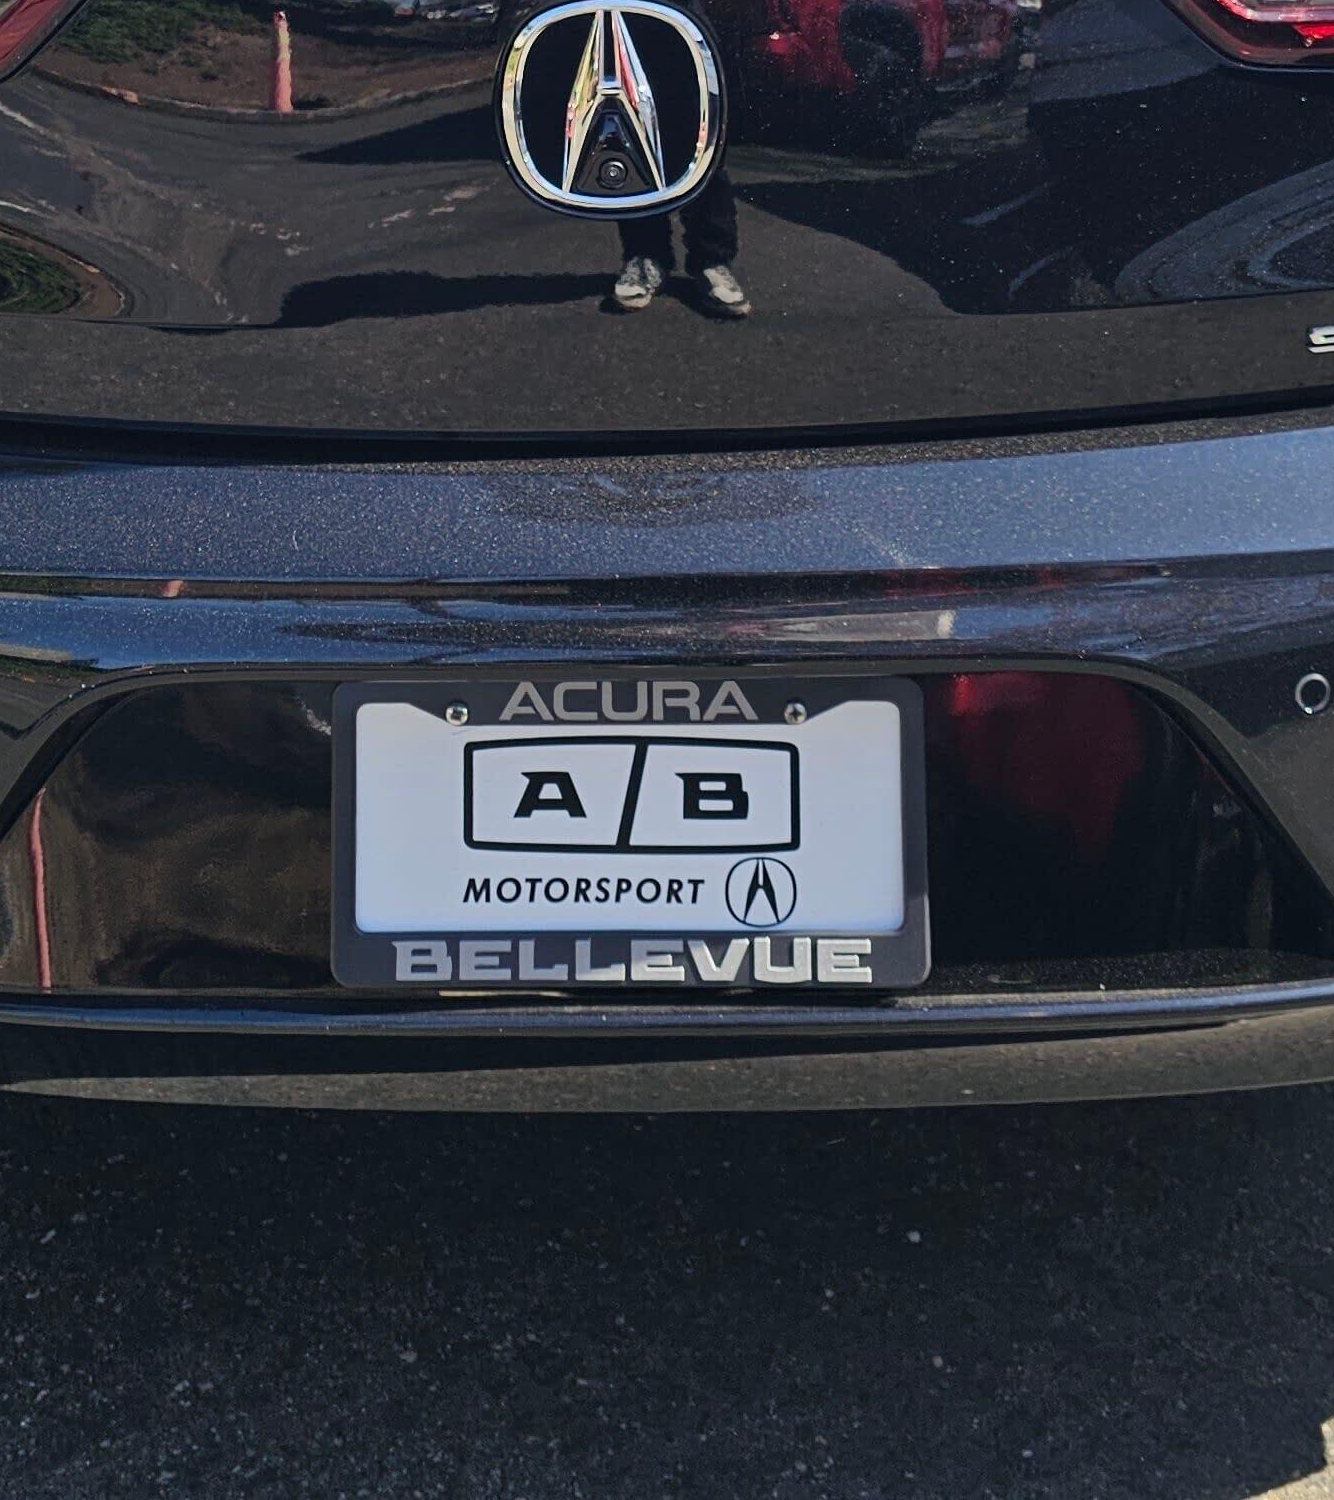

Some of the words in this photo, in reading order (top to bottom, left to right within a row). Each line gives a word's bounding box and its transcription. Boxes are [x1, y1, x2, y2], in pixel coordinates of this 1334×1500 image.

[498, 680, 759, 722] ACURA
[462, 876, 706, 905] MOTORSPORT
[391, 936, 873, 984] BELLEVUE
